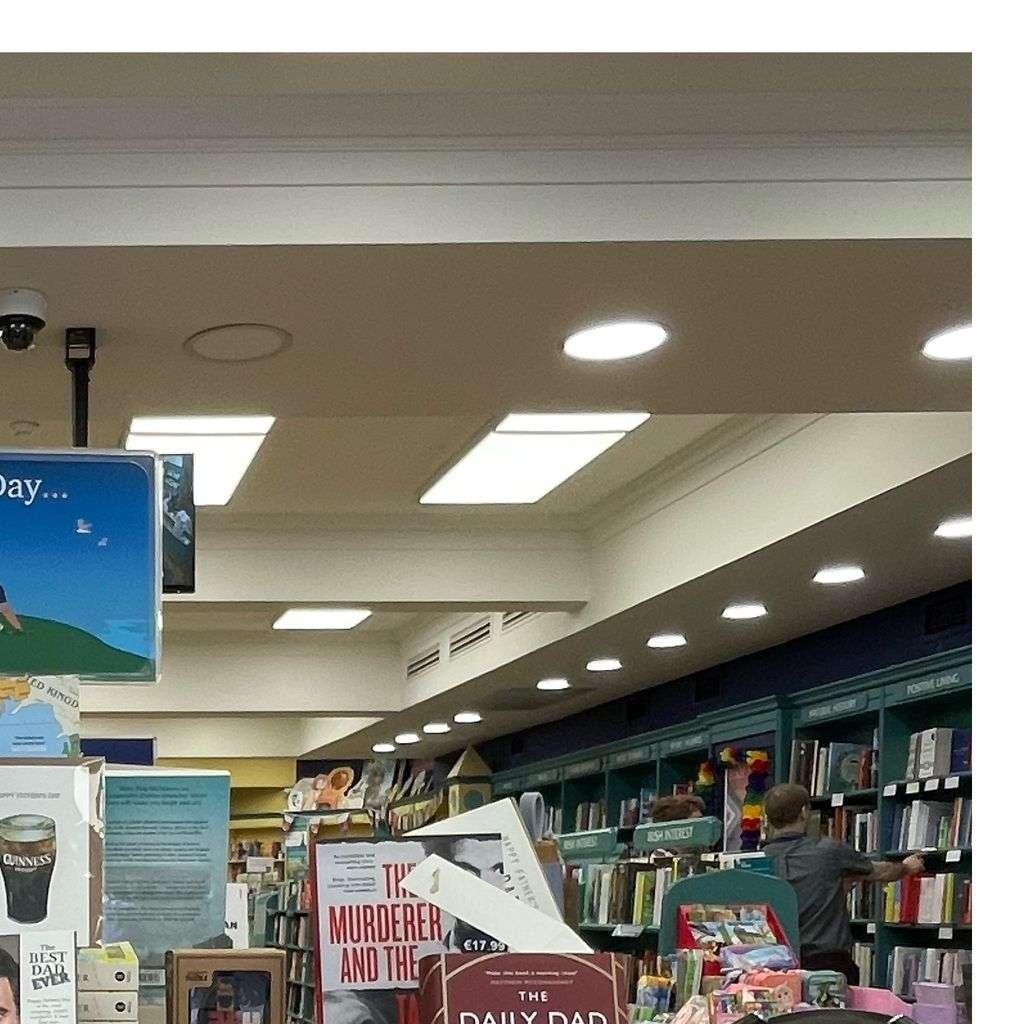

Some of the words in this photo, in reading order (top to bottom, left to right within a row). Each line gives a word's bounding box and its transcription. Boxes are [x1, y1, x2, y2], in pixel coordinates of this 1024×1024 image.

[2, 852, 53, 868] GUINNESS
[328, 902, 443, 945] MURDERER
[28, 951, 68, 965] BEST
[340, 946, 377, 983] AND
[383, 945, 420, 982] THE
[30, 963, 65, 976] DAD
[31, 972, 71, 991] EVER
[518, 990, 549, 1003] THE
